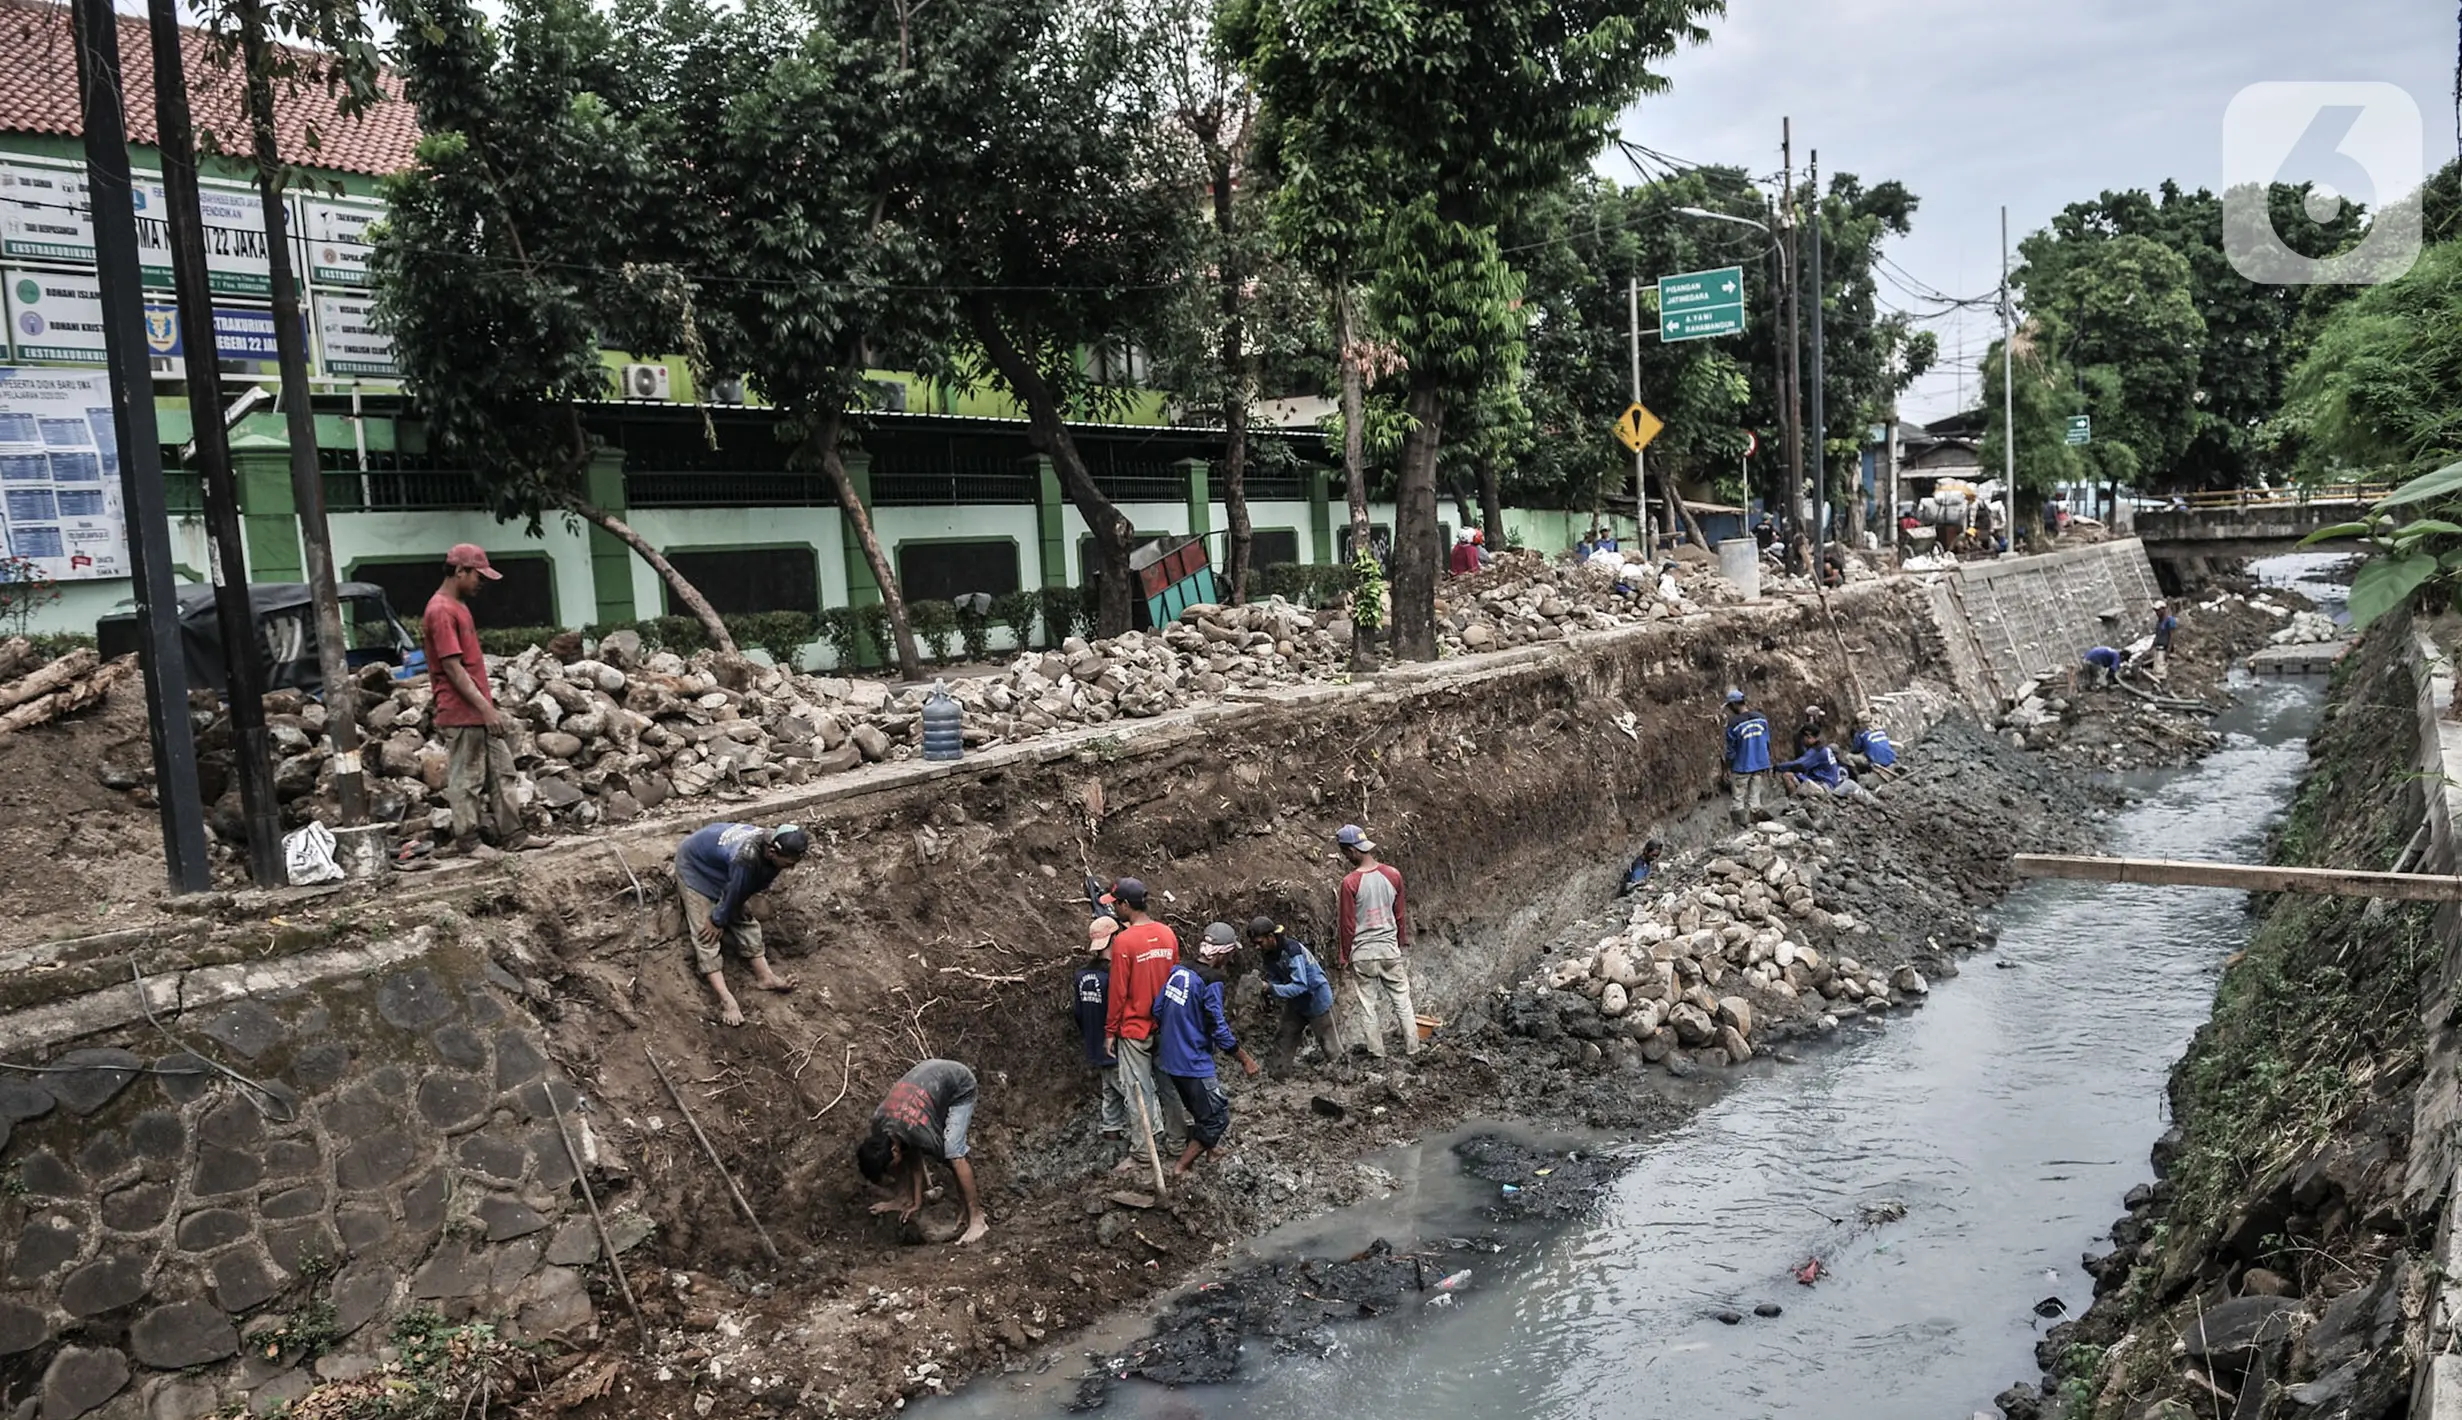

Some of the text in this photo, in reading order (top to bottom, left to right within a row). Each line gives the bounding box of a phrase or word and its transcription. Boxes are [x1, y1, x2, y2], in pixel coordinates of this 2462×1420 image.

[213, 228, 230, 256] 22
[233, 230, 268, 260] JAKA
[1665, 283, 1701, 294] PISANGAN
[1667, 292, 1710, 305] JATINEGARA
[248, 337, 262, 351] 22
